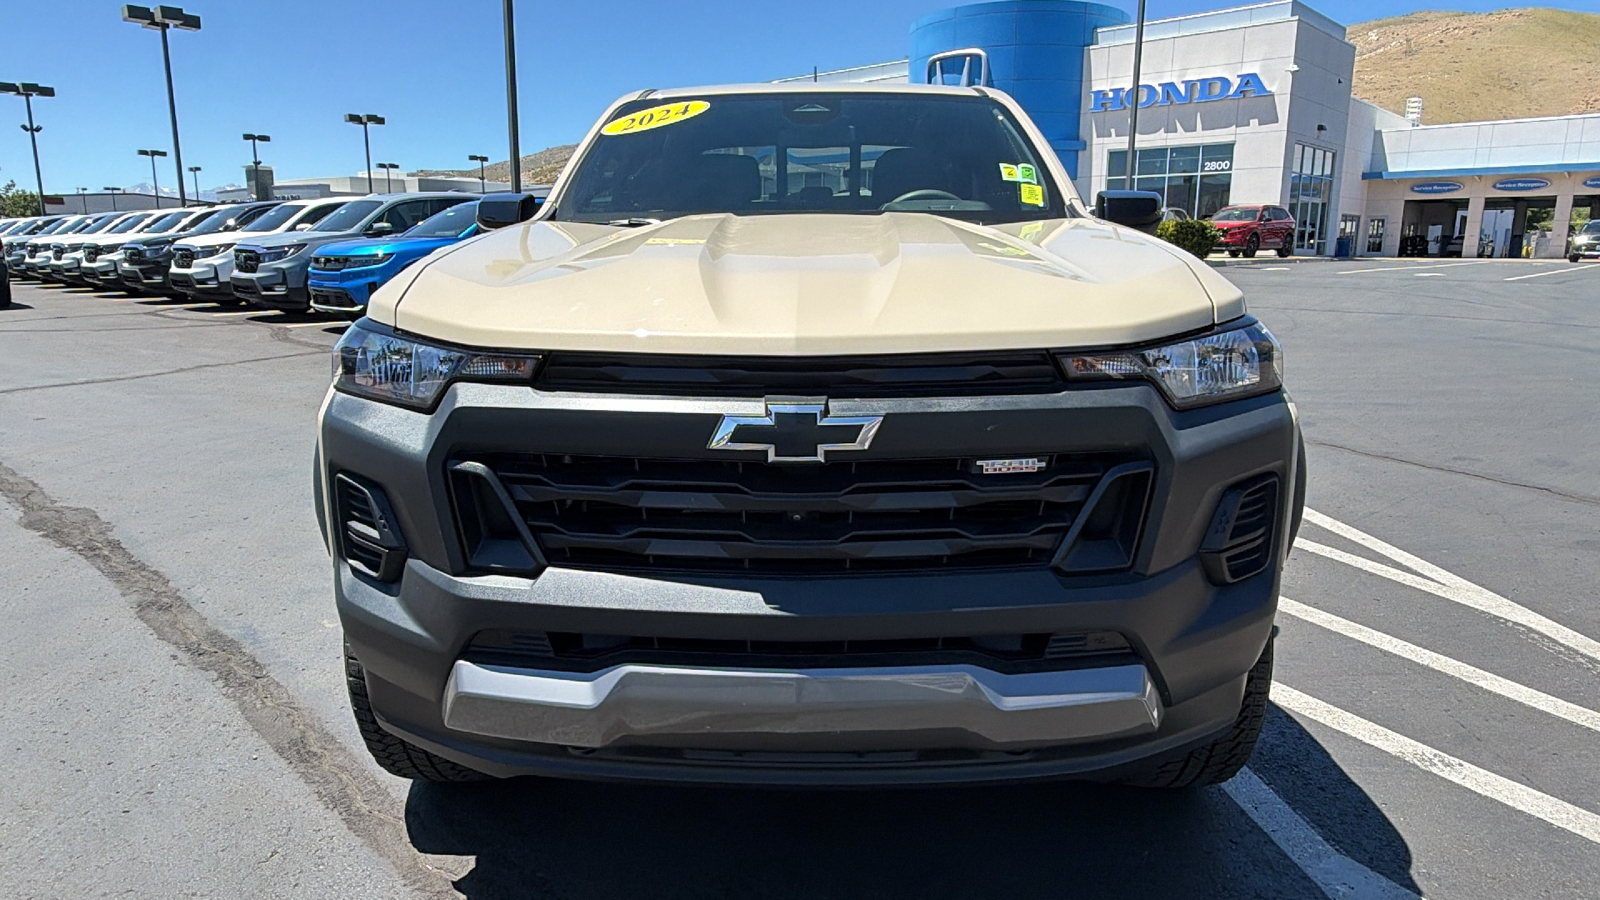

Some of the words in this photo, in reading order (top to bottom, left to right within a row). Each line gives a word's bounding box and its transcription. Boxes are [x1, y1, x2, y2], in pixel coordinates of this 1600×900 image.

[1089, 72, 1274, 112] HONDA
[621, 103, 691, 131] 2024
[1204, 160, 1230, 171] 2800
[976, 458, 1046, 467] TRAIL
